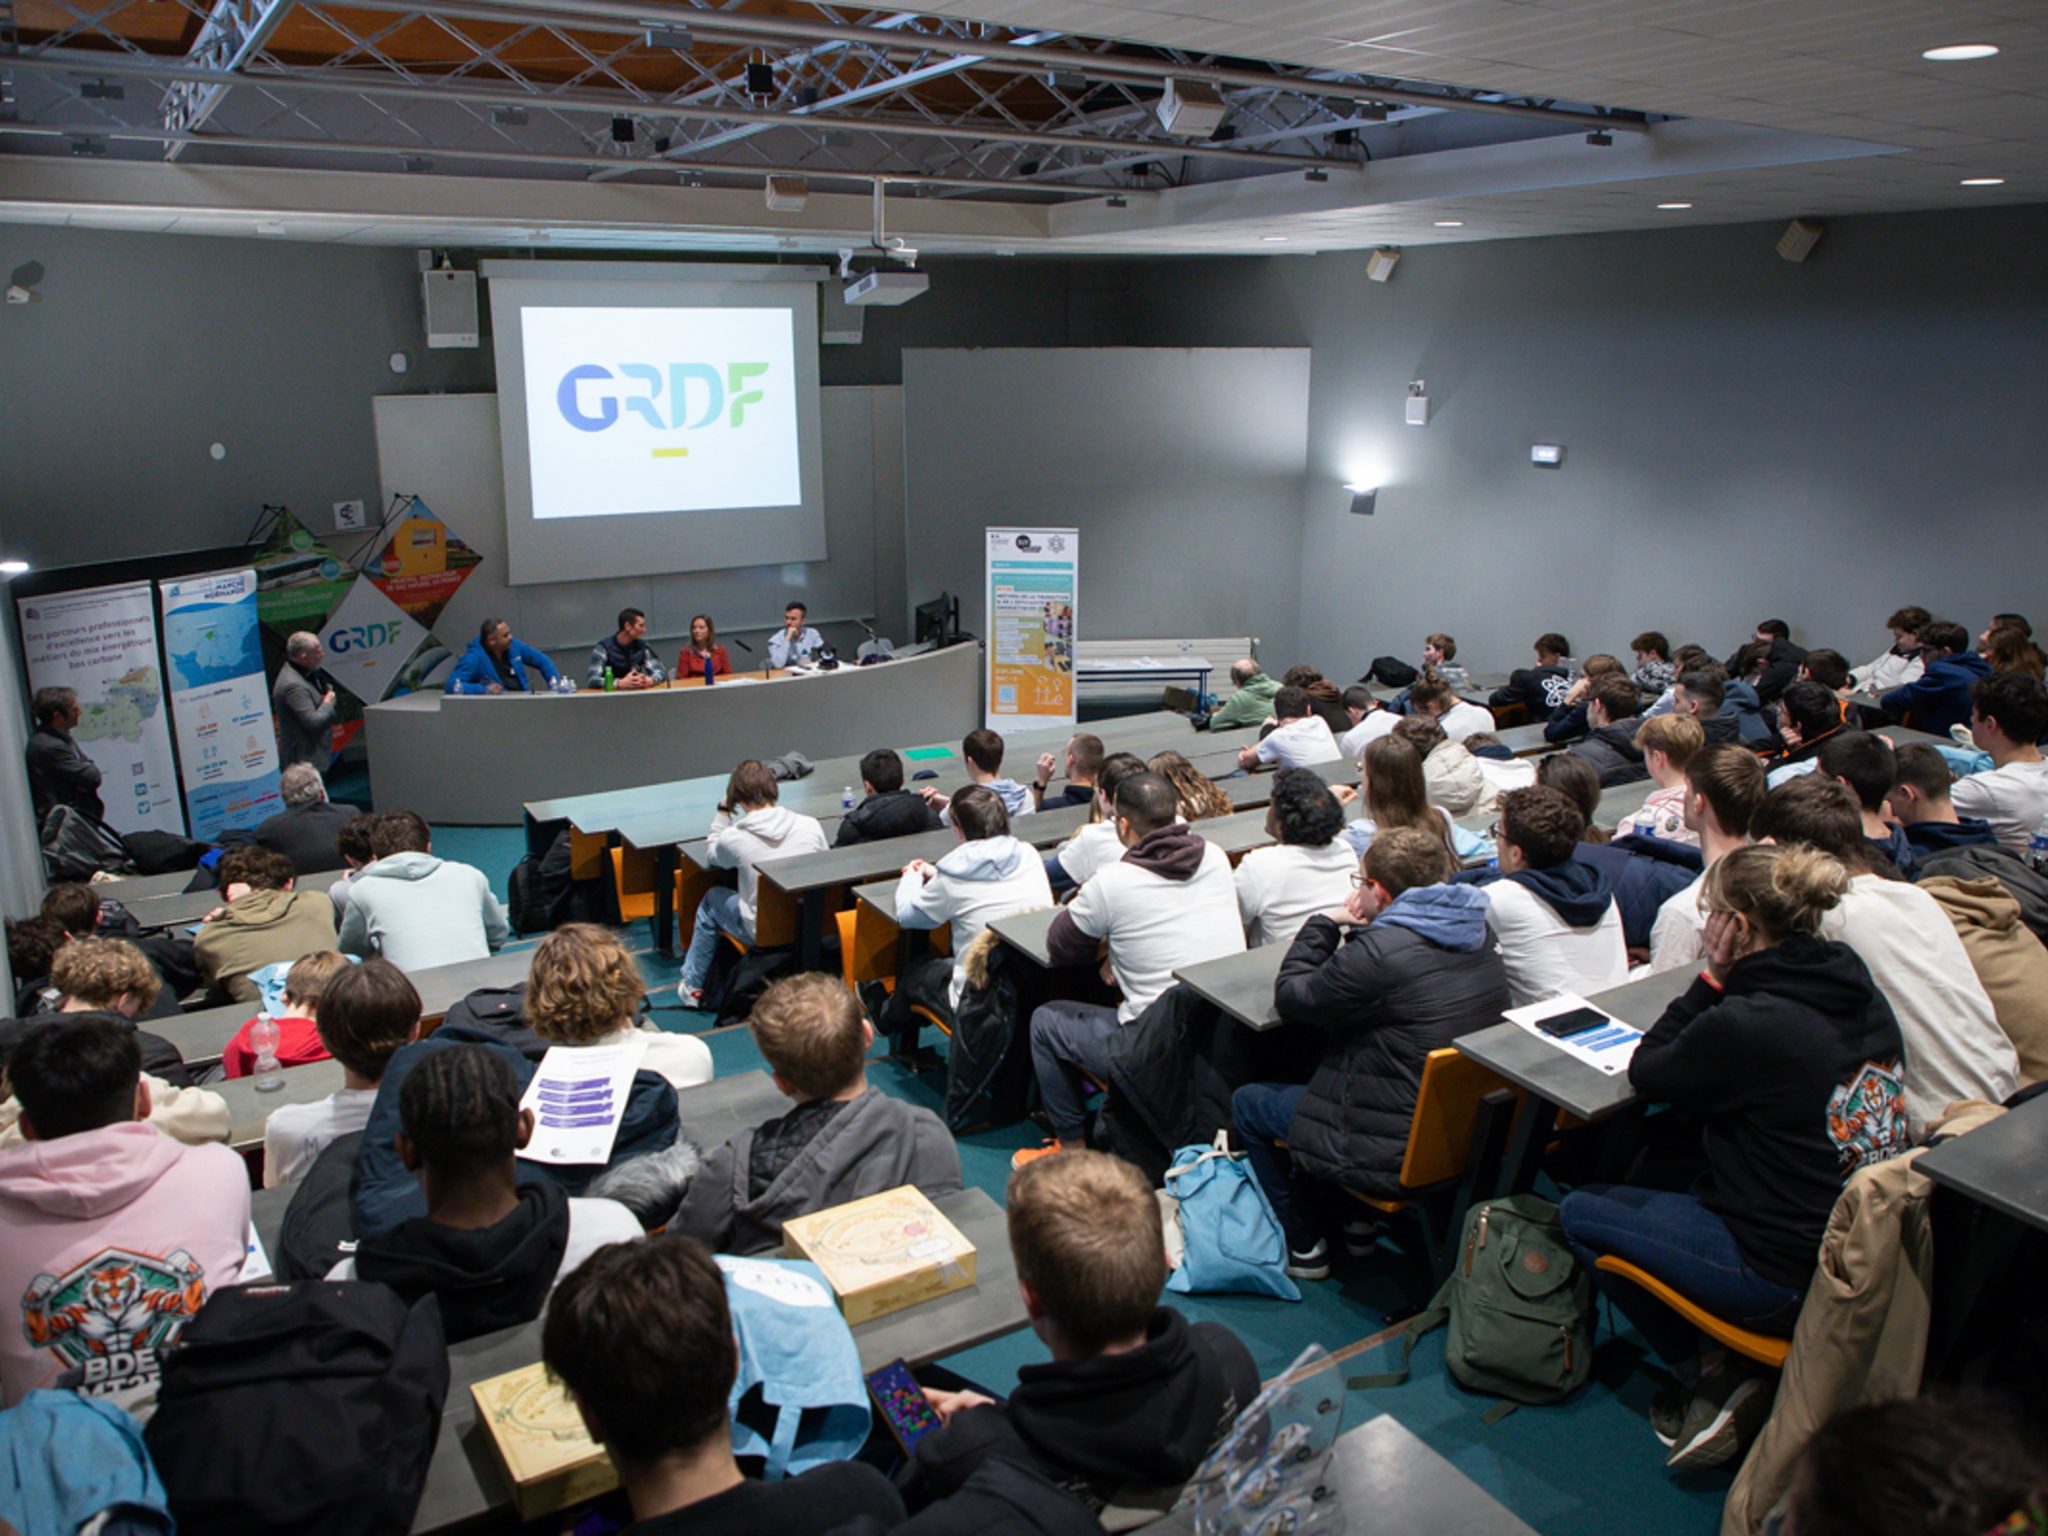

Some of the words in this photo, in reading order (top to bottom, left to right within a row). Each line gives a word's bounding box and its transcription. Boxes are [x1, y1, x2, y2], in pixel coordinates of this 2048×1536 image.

[557, 362, 769, 432] GRDF
[46, 627, 87, 640] parcours
[103, 631, 121, 641] vers
[329, 620, 402, 653] GRDF
[88, 653, 123, 666] carbone
[84, 1347, 160, 1384] BDE
